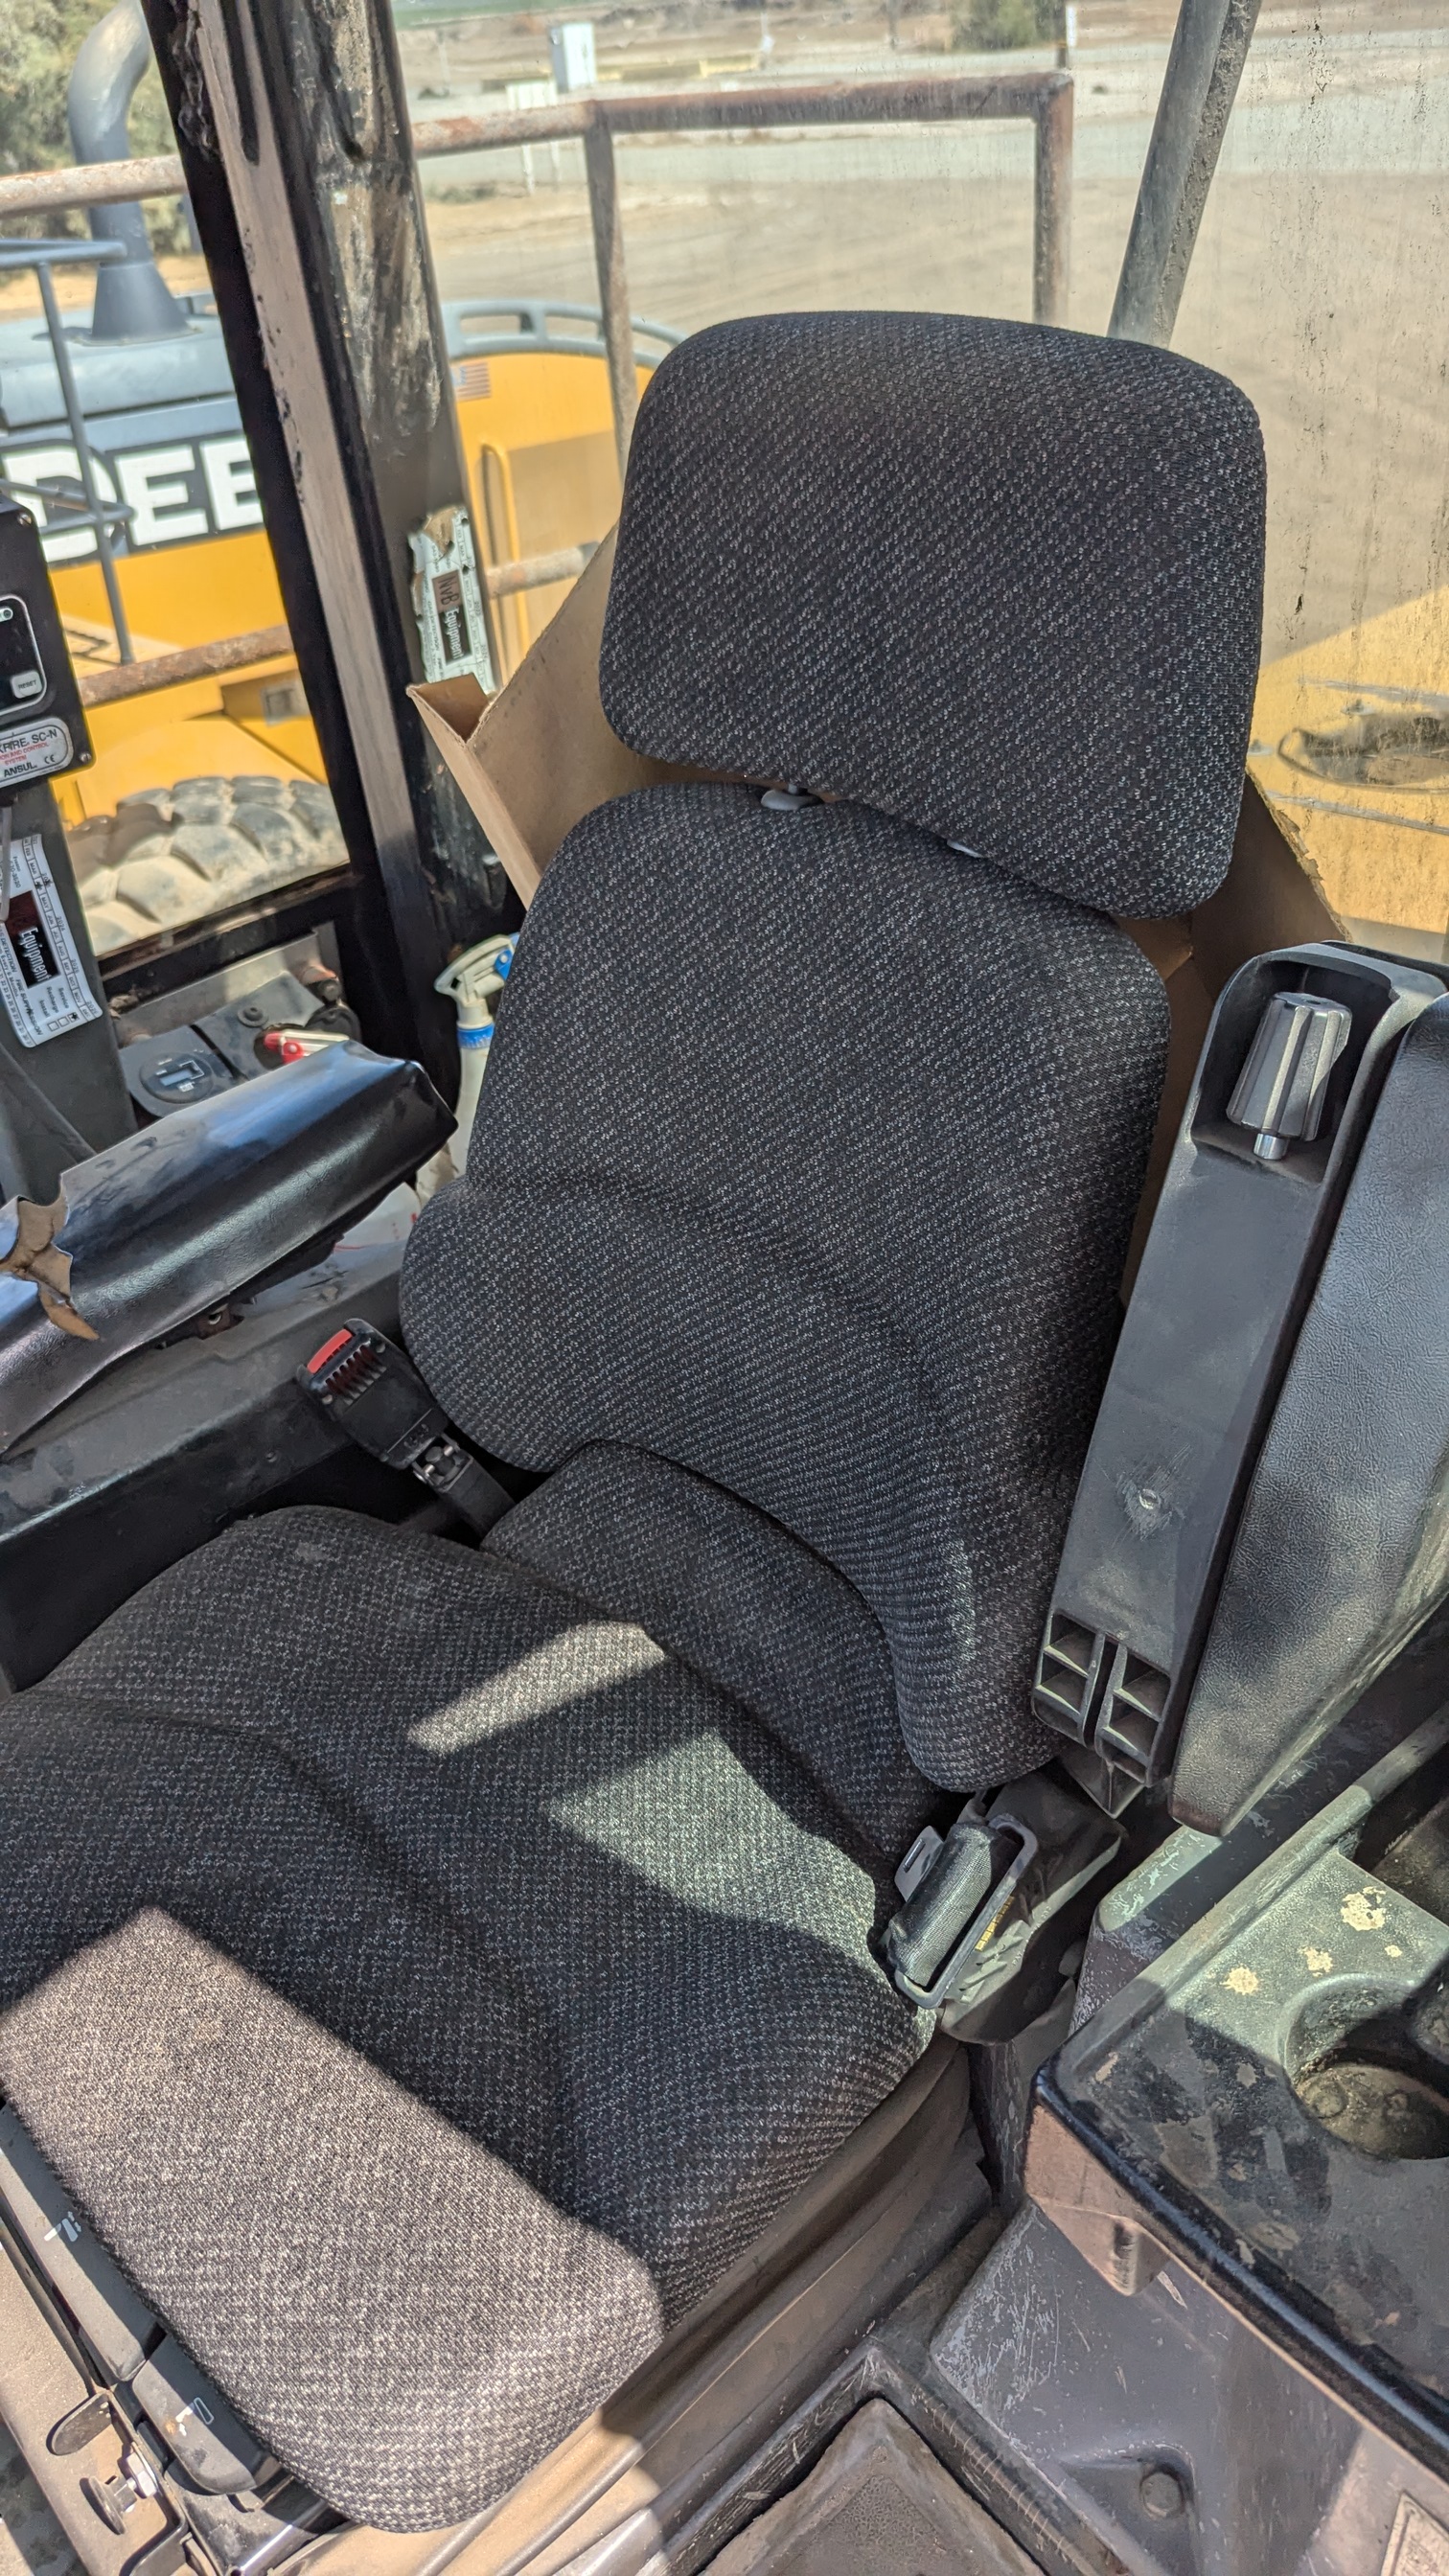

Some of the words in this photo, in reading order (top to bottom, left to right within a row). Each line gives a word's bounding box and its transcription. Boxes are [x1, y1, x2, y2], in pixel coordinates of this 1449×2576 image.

[438, 576, 460, 606] NvB
[444, 608, 466, 659] Equipment
[18, 679, 36, 690] RESET
[32, 729, 58, 744] SC-N
[23, 743, 49, 754] CONTROL
[4, 762, 35, 777] ANSUL
[57, 916, 65, 932] 2024
[1, 937, 17, 973] DETECTION
[20, 927, 51, 982] Equipment
[46, 986, 59, 1014] Recharge
[58, 987, 70, 1009] Service
